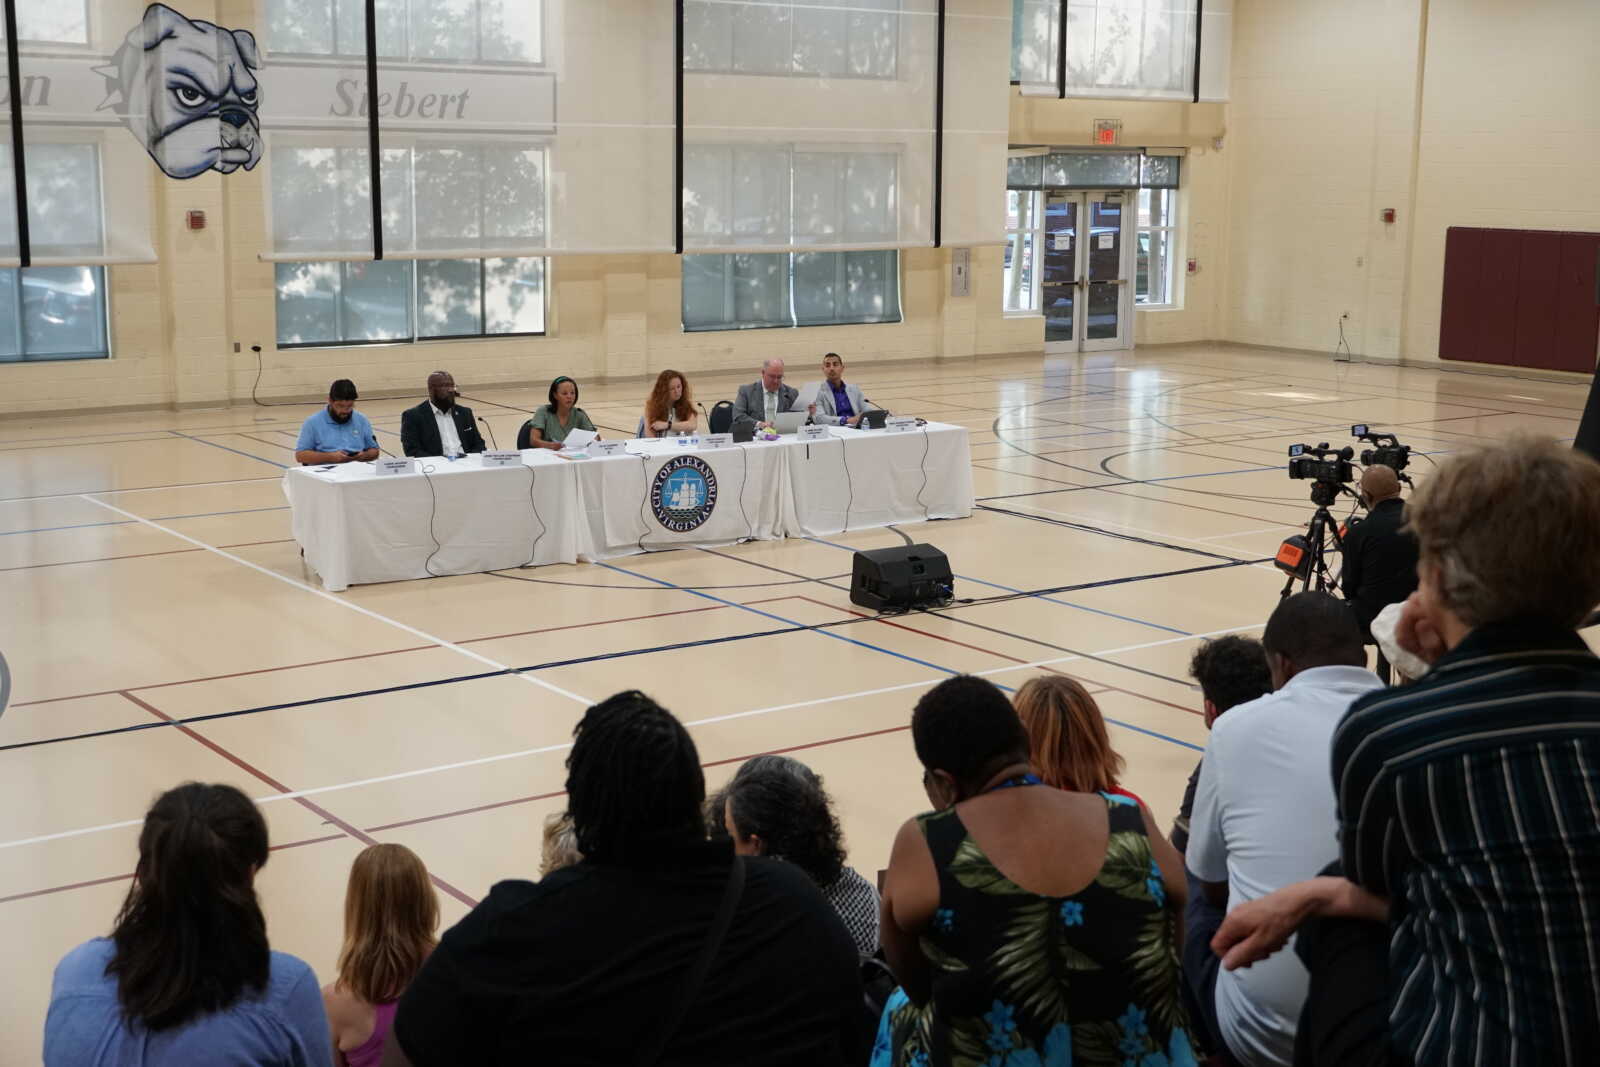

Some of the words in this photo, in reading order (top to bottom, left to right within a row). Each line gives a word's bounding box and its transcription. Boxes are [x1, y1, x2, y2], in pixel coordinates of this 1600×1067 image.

[328, 78, 470, 119] Siebert
[652, 480, 663, 507] CITY
[660, 463, 672, 479] OF
[673, 457, 716, 506] ALEXANDRIA
[658, 510, 709, 530] VIRGINIA
